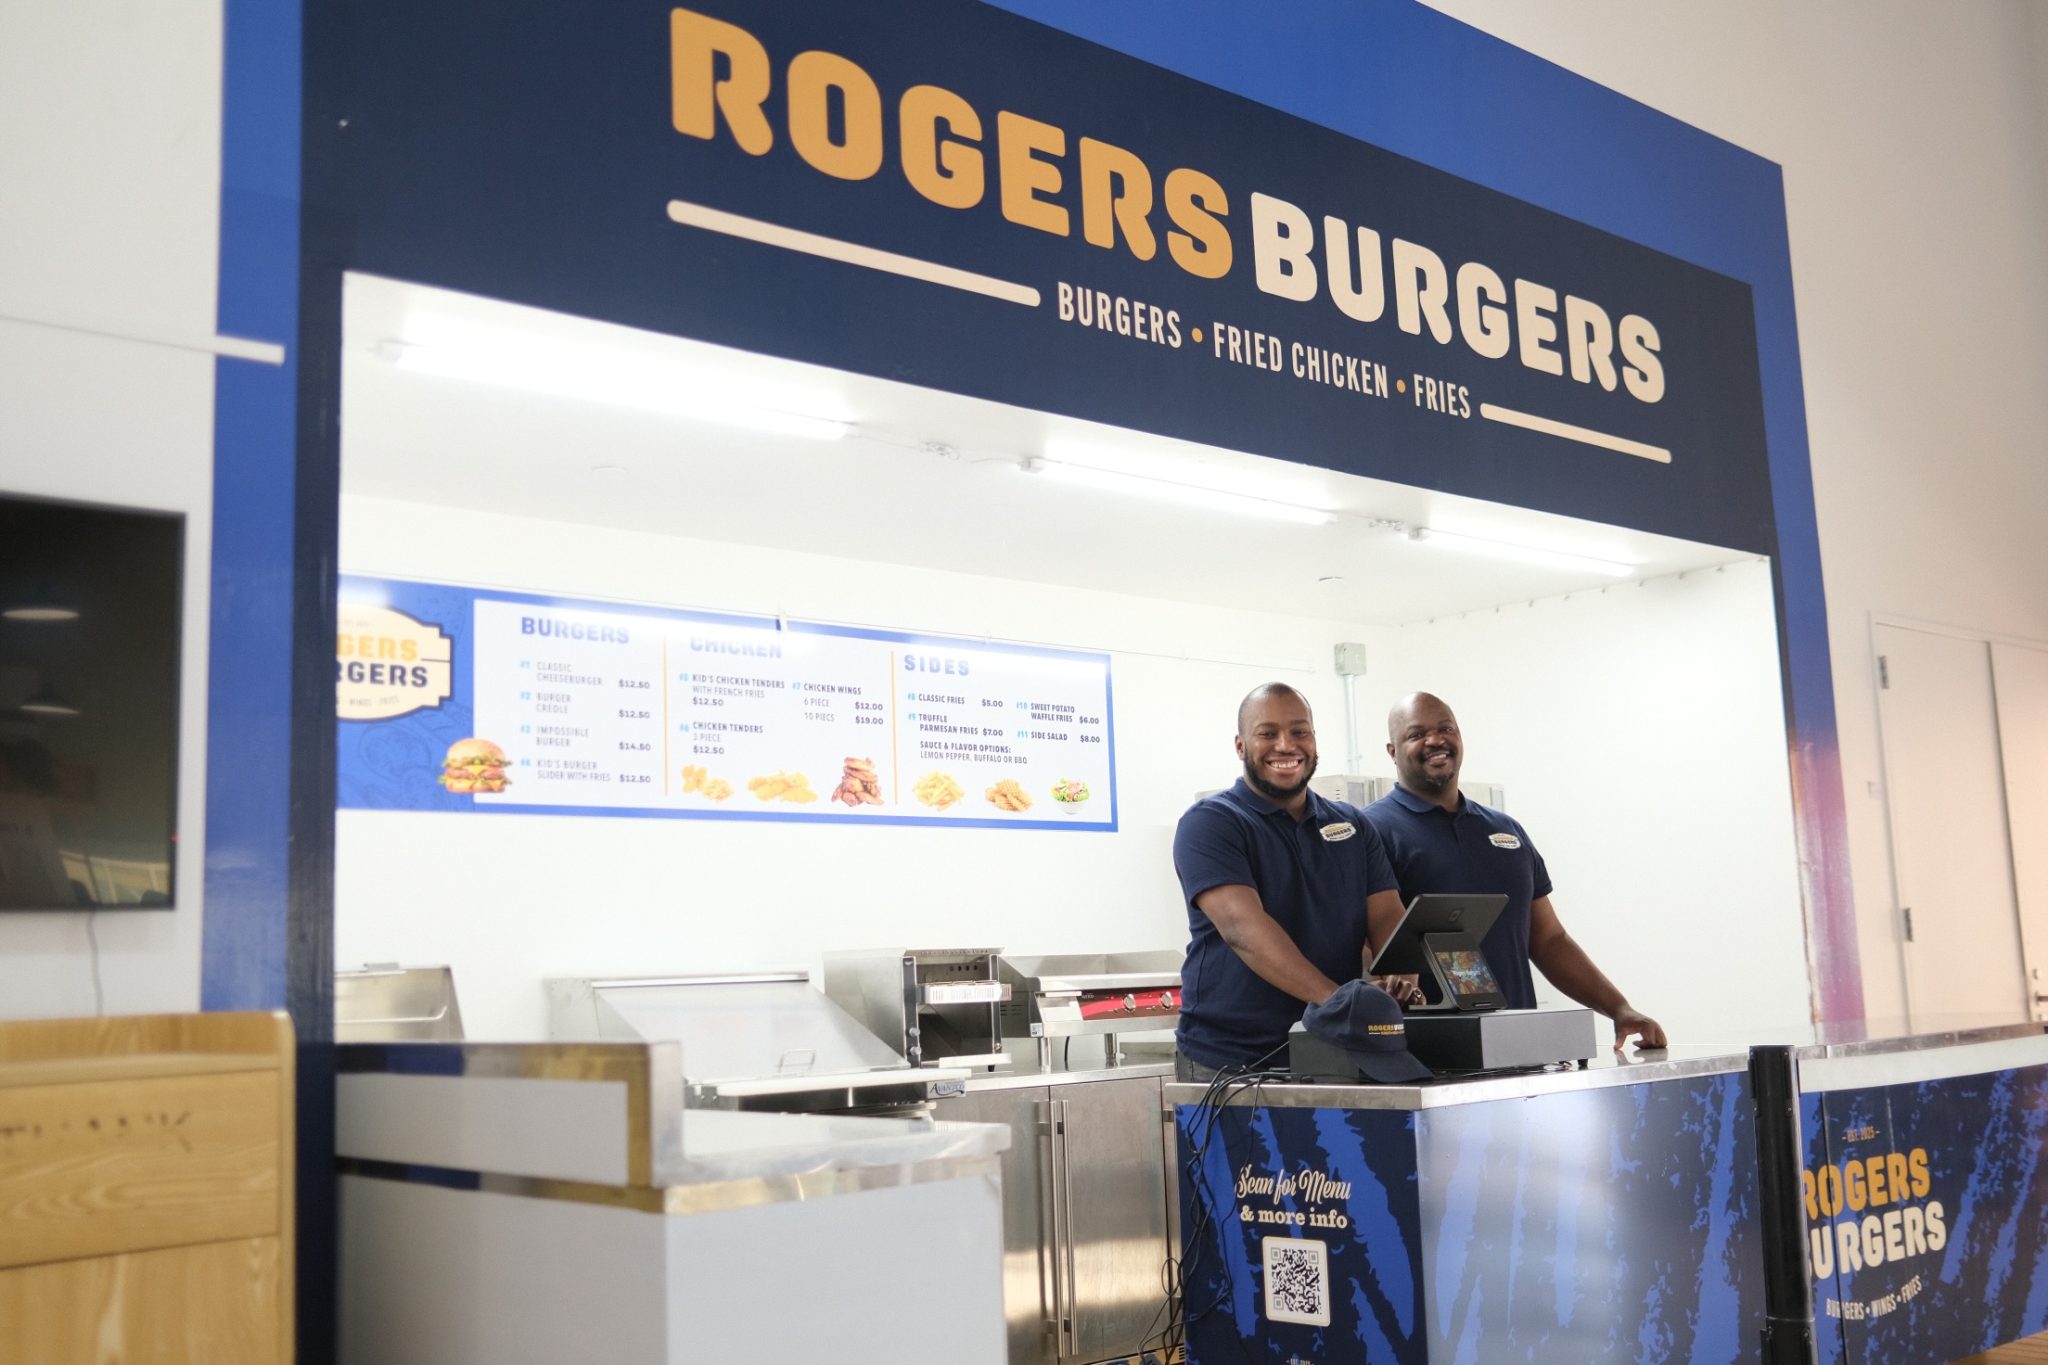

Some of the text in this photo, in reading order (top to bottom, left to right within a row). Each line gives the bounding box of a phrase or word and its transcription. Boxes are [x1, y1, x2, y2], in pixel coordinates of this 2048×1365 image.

[671, 7, 1666, 403] ROGERS BURGERS
[1058, 282, 1471, 419] BURGERS FRIED CHICKEN FRIES
[521, 616, 630, 644] BURGERS
[690, 635, 783, 659] CHICKEN
[537, 661, 572, 672] CLASSIC
[904, 654, 970, 676] SIDES
[537, 673, 602, 685] CHEESEBURGER
[619, 679, 650, 689] $12.50
[692, 674, 714, 683] KID'S
[716, 675, 750, 686] CHICKEN
[752, 679, 785, 689] TENDERS
[692, 685, 765, 698] WITH FRENCH FRIES
[804, 683, 835, 693] CHICKEN
[838, 686, 862, 695] WINGS
[537, 691, 571, 703] BURGER
[693, 696, 724, 706] $12.50
[810, 698, 830, 707] PIECE
[918, 694, 945, 703] CLASSIC
[947, 696, 965, 704] FRIES
[855, 701, 883, 711] $12.00
[982, 698, 1003, 708] $5.00
[1031, 702, 1050, 711] SWEET
[1052, 705, 1075, 713] POTATO
[619, 709, 650, 719] $12.50
[918, 713, 947, 723] TRUFFLE
[1031, 712, 1073, 723] WAFFLE FRIES
[855, 715, 883, 725] $19.00
[1079, 716, 1099, 725] $6.00
[537, 726, 589, 737] IMPOSSIBLE
[693, 721, 727, 731] CHICKEN
[730, 724, 763, 734] TENDERS
[920, 723, 978, 735] PARMESAN FRIES
[982, 728, 1003, 737] $7.00
[536, 736, 571, 747] BURGER
[700, 734, 721, 742] PIECE
[1031, 731, 1046, 739] SIDE
[1047, 732, 1068, 741] SALAD
[1080, 734, 1100, 743] $8.00
[619, 741, 651, 751] $14.50
[693, 745, 725, 755] $12.50
[920, 741, 1011, 753] SAUCE & FLAVOR OPTIONS:
[920, 751, 1028, 764] LEMON PEPPER, BUFFALO OR BBQ
[564, 760, 597, 770] BURGER
[567, 771, 587, 781] WITH
[590, 772, 611, 782] FRIES
[619, 774, 651, 783] $12.50
[1237, 1164, 1352, 1205] Scan for Menu
[1802, 1148, 1930, 1220] ROGERS
[1240, 1205, 1348, 1229] & more info
[1808, 1201, 1946, 1280] URGERS
[1871, 1293, 1897, 1317] WINGS
[1901, 1274, 1923, 1303] FRIES
